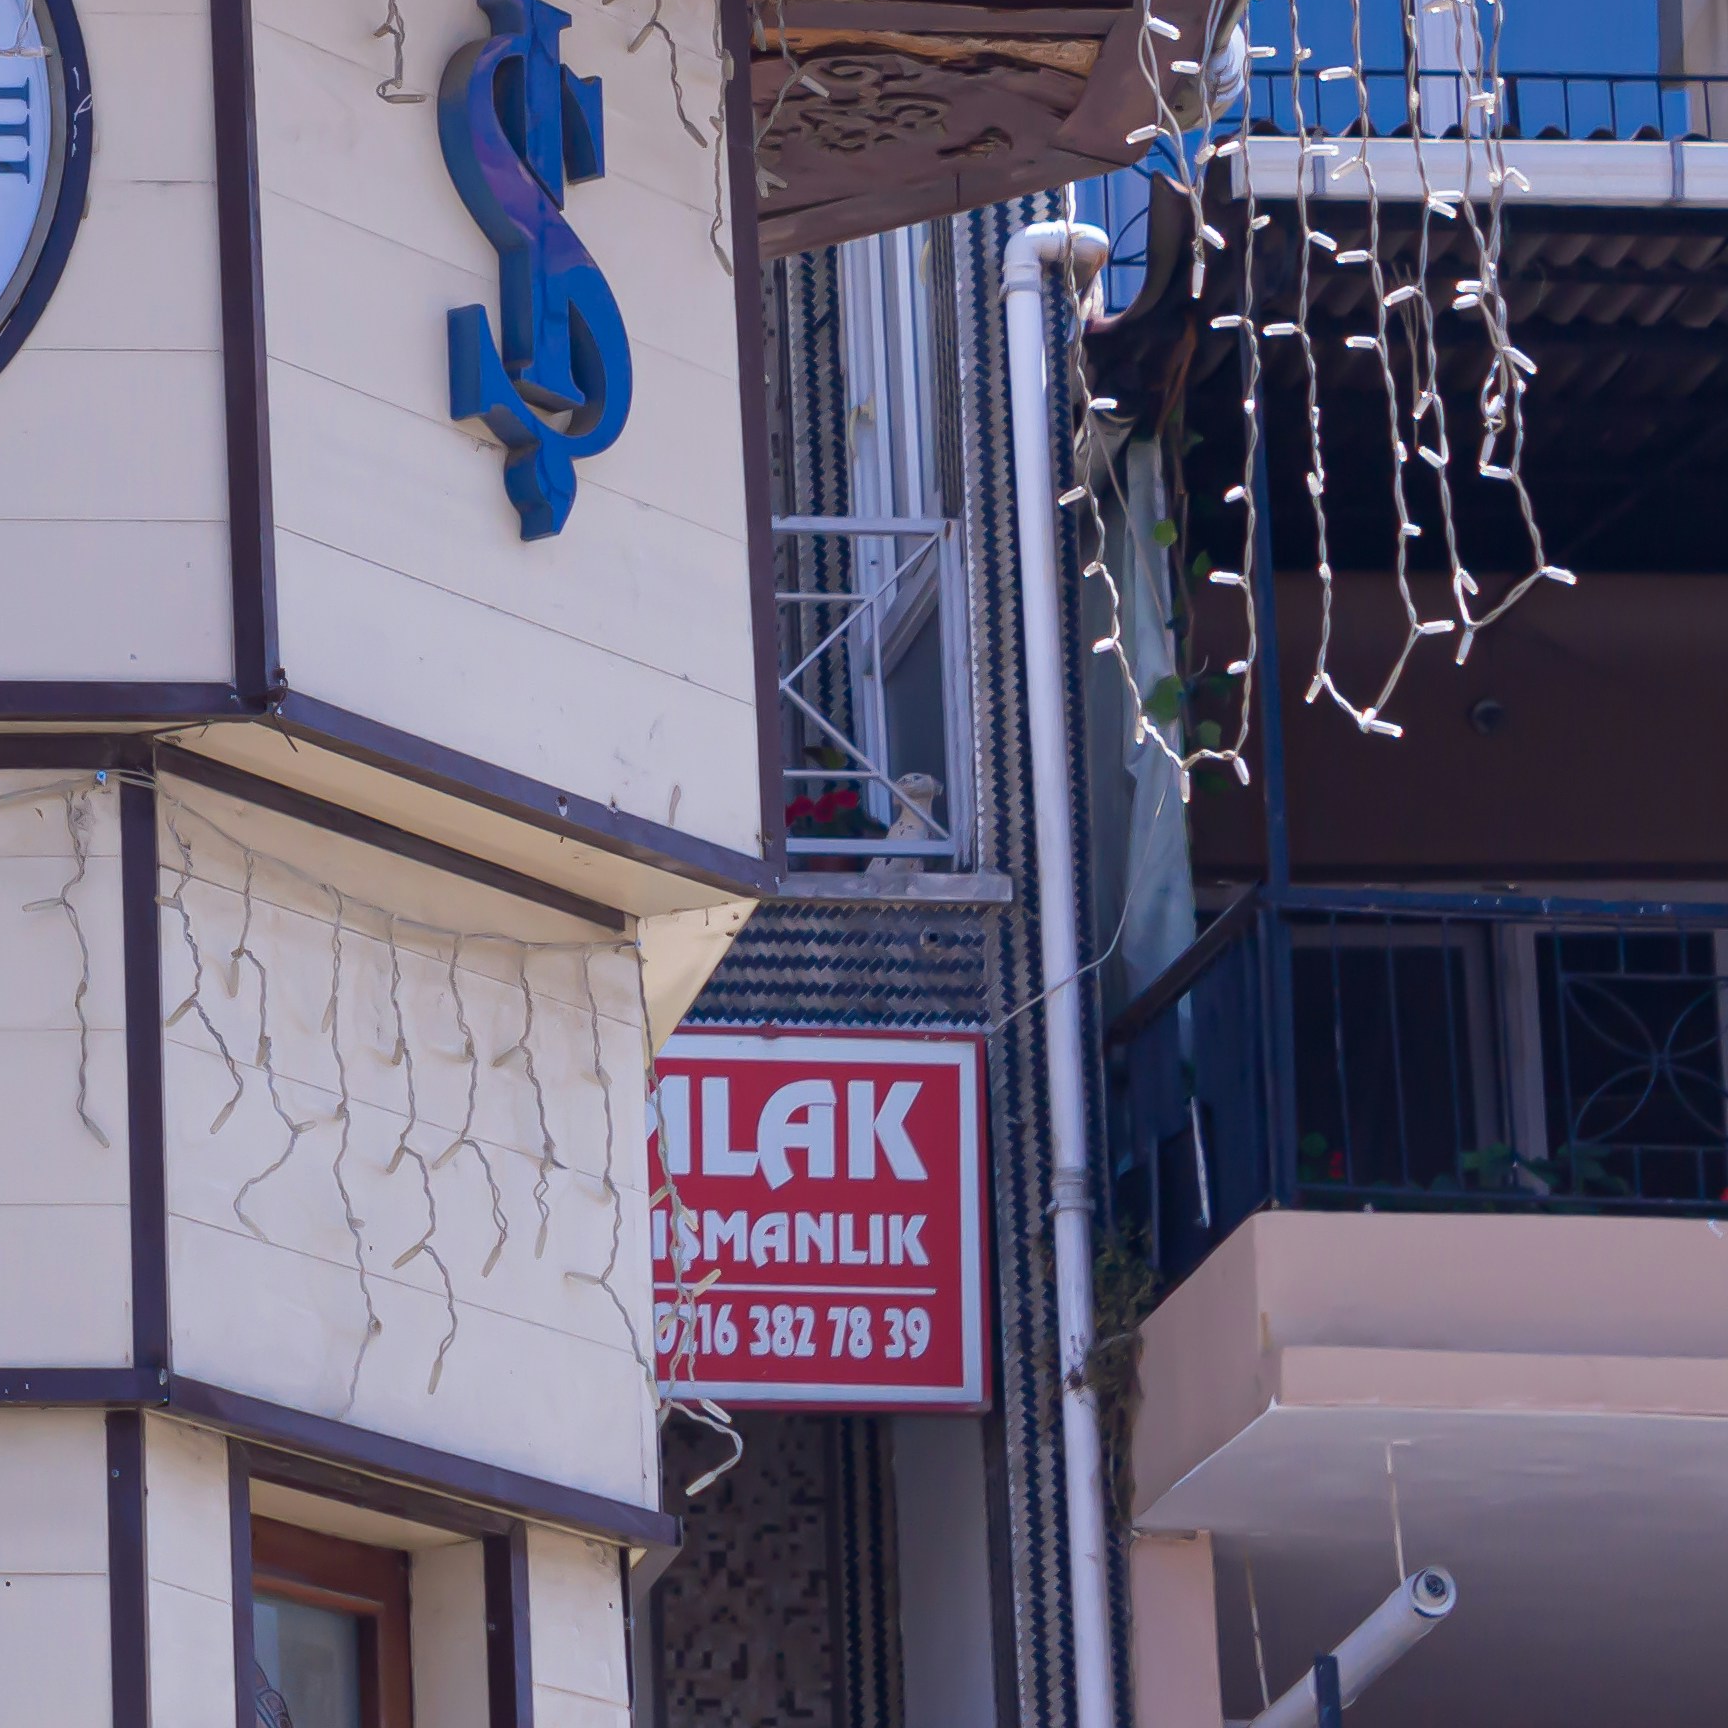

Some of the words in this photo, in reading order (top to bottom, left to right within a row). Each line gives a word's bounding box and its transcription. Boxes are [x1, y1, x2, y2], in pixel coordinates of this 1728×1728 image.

[749, 1304, 816, 1358] 382
[827, 1306, 873, 1359] 78
[884, 1307, 931, 1359] 39
